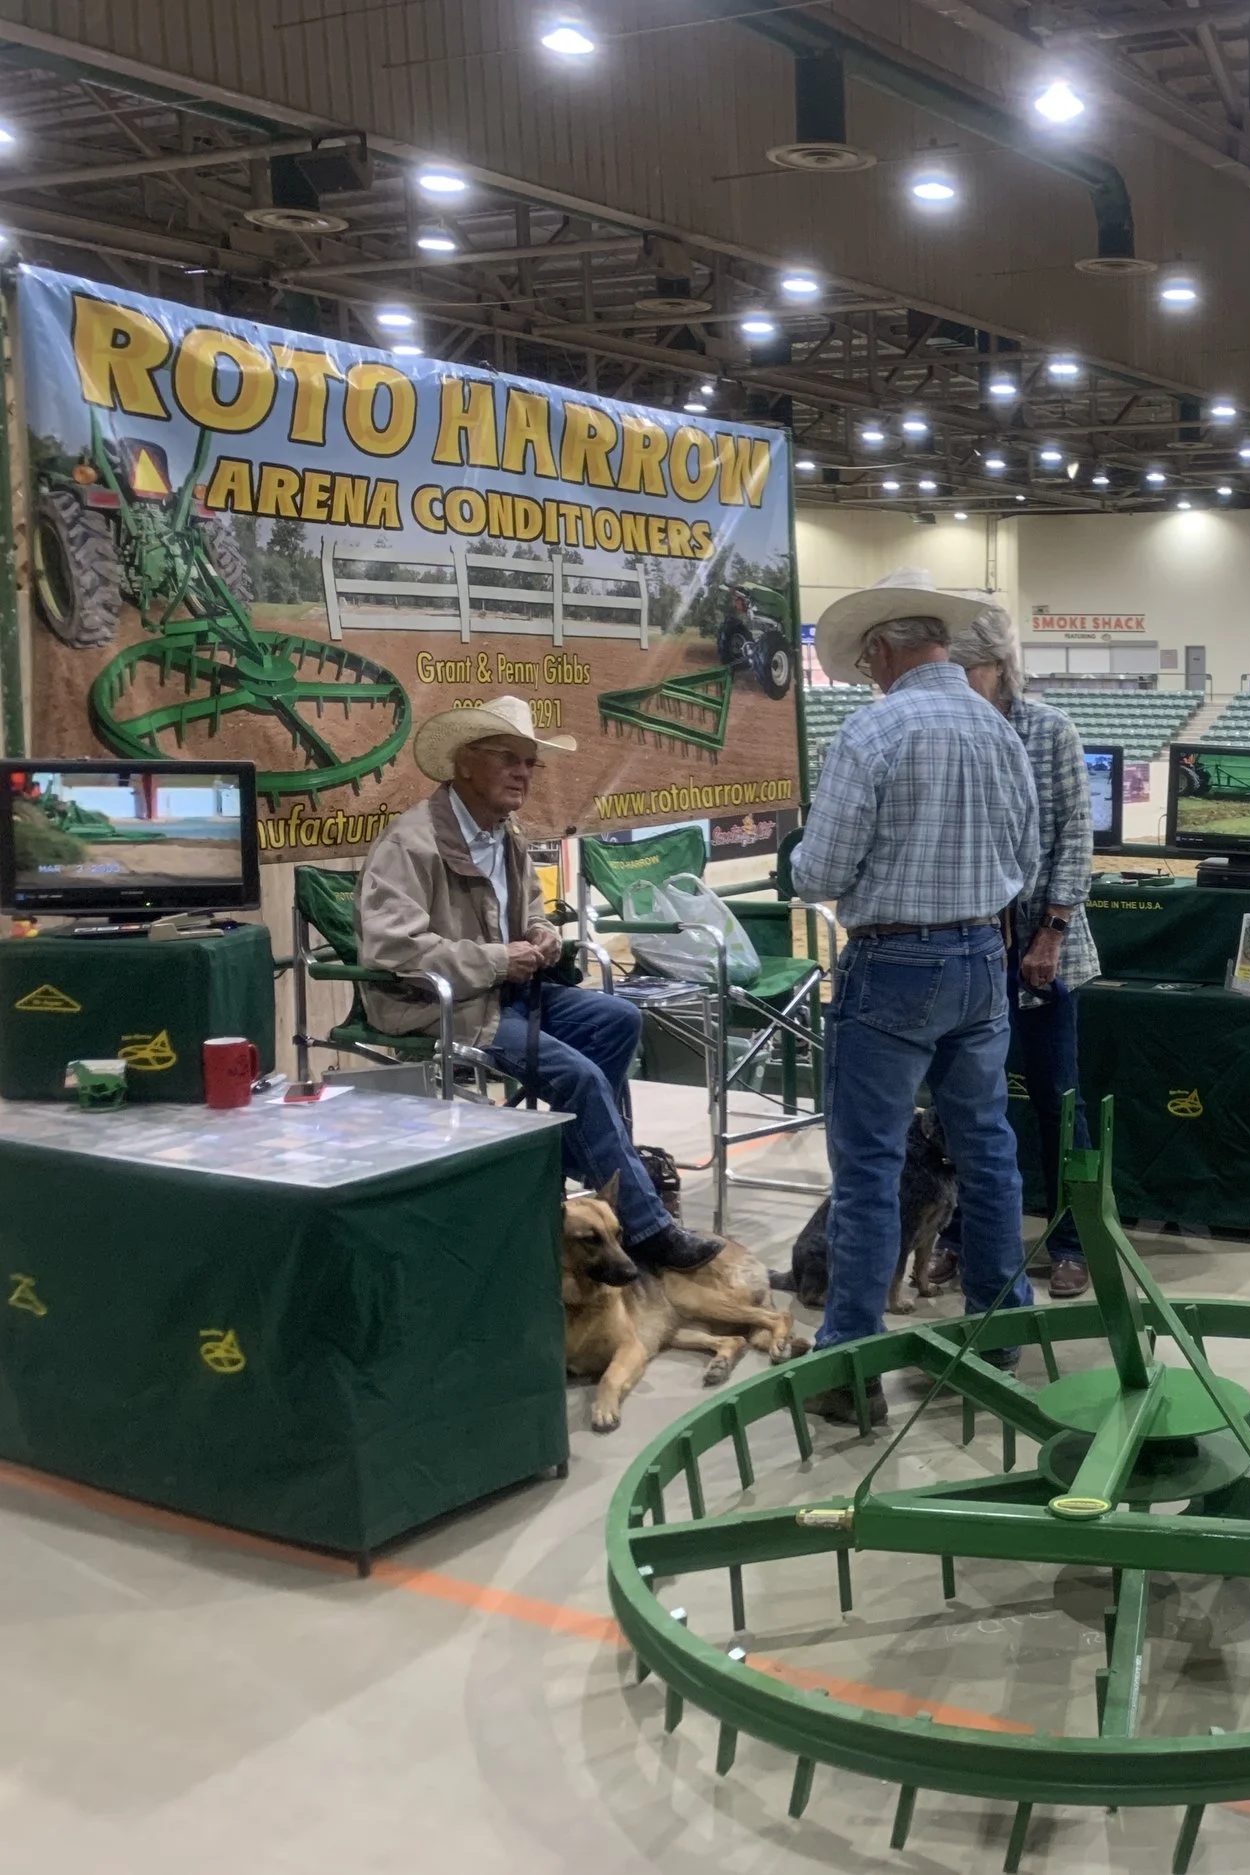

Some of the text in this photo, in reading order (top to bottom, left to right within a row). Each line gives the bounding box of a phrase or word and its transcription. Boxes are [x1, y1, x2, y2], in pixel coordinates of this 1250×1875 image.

[71, 291, 771, 508] ROTO HARROW
[206, 455, 715, 560] ARENA CONDITIONERS
[1032, 616, 1145, 630] SMOKE SHACK
[416, 651, 591, 690] Grant & Penny Gibbs
[595, 776, 792, 820] www.rotoharrow.com
[1085, 900, 1164, 910] MADE IN THE U.S.A.
